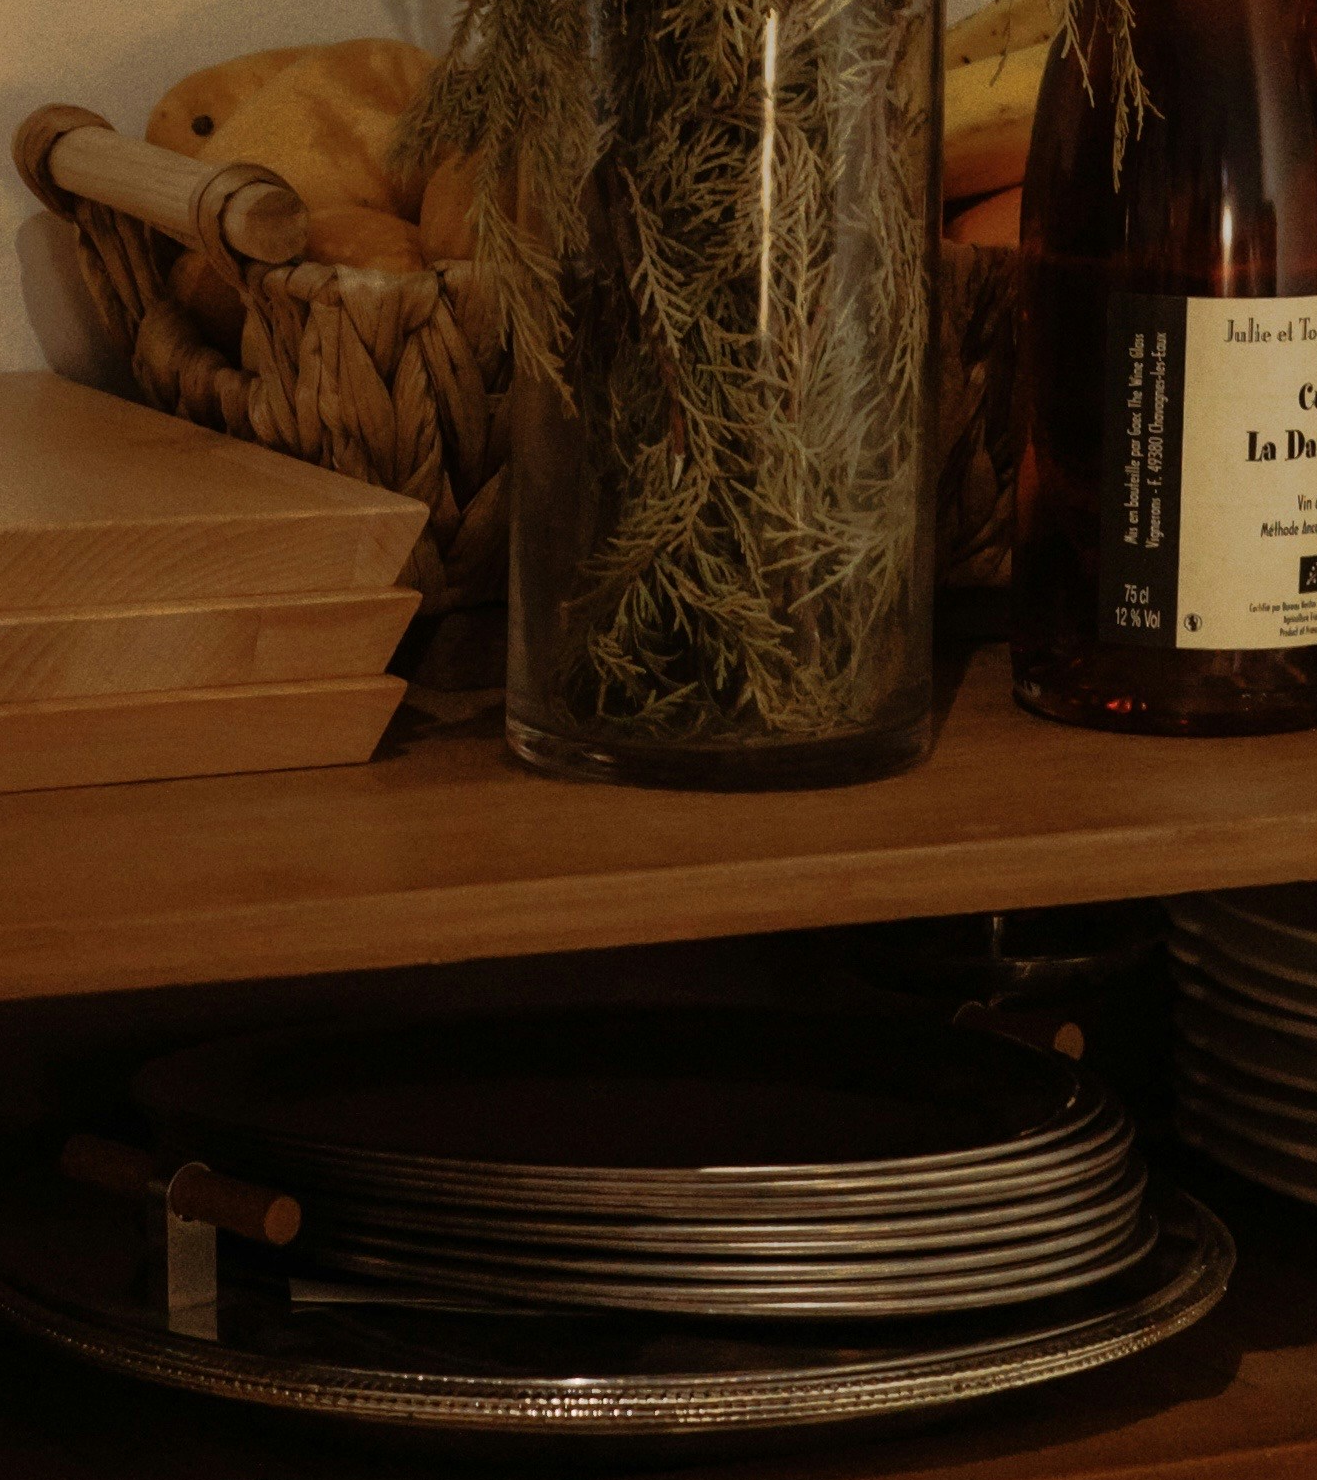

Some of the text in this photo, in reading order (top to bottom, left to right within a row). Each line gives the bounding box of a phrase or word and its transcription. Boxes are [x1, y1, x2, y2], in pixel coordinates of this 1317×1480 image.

[1224, 317, 1272, 343] Julie
[1276, 321, 1293, 342] et
[1146, 437, 1164, 473] 49380
[1245, 430, 1277, 463] La
[1122, 460, 1141, 508] bouteille
[1297, 494, 1312, 511] Vin
[1127, 510, 1140, 524] en
[1145, 497, 1165, 549] Vignerons
[1123, 527, 1139, 545] Mis
[1124, 583, 1150, 605] 75 cl
[1115, 606, 1161, 629] 12 % Vol
